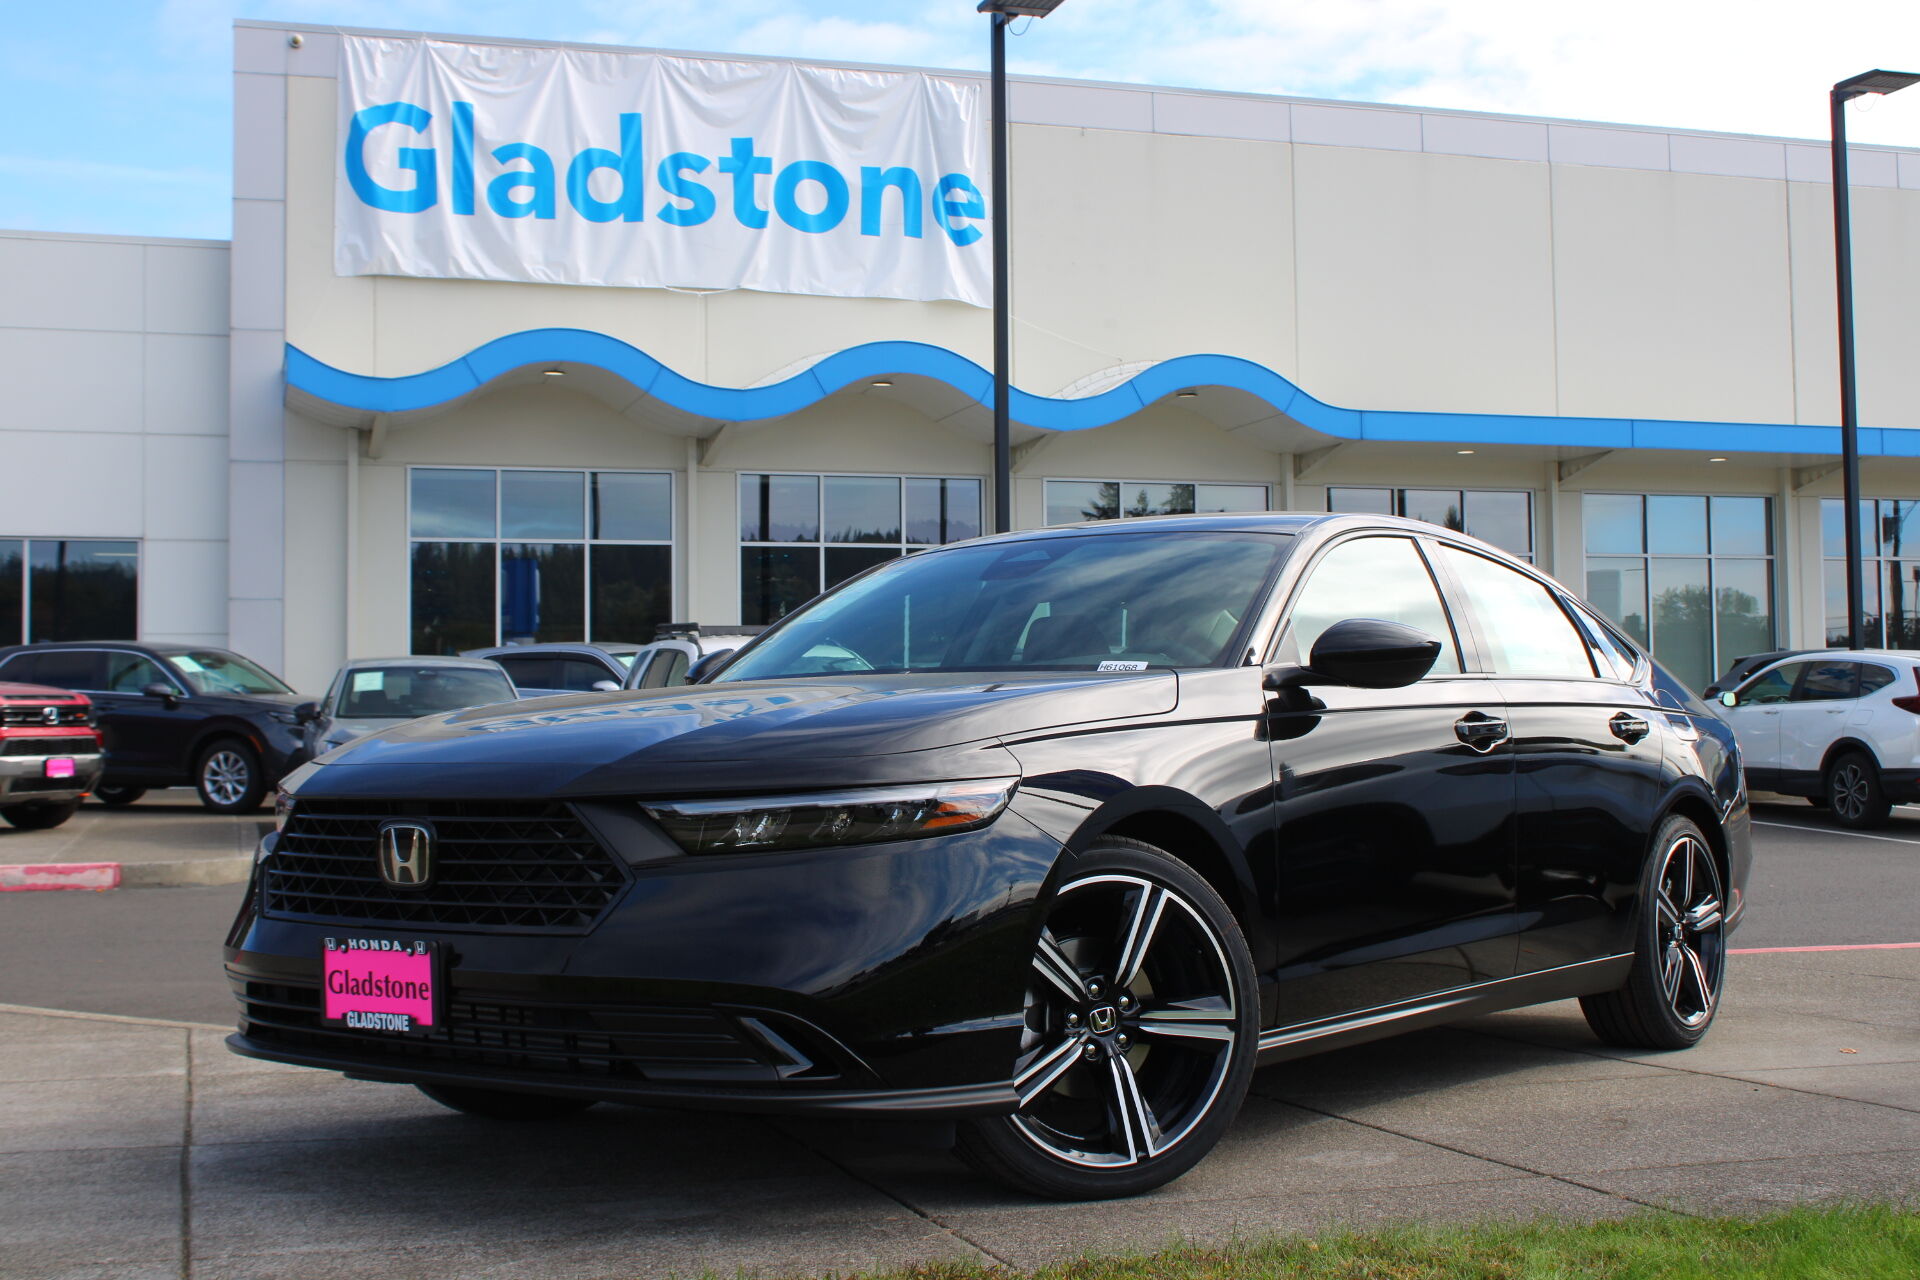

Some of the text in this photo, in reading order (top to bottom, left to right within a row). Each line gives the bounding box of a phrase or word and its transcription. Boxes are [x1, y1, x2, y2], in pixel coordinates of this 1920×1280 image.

[345, 101, 985, 247] Gladstone
[1100, 663, 1138, 671] H61068
[348, 939, 402, 951] HONDA
[328, 969, 430, 1001] Gladstone
[346, 1011, 410, 1032] GLADSTONE
